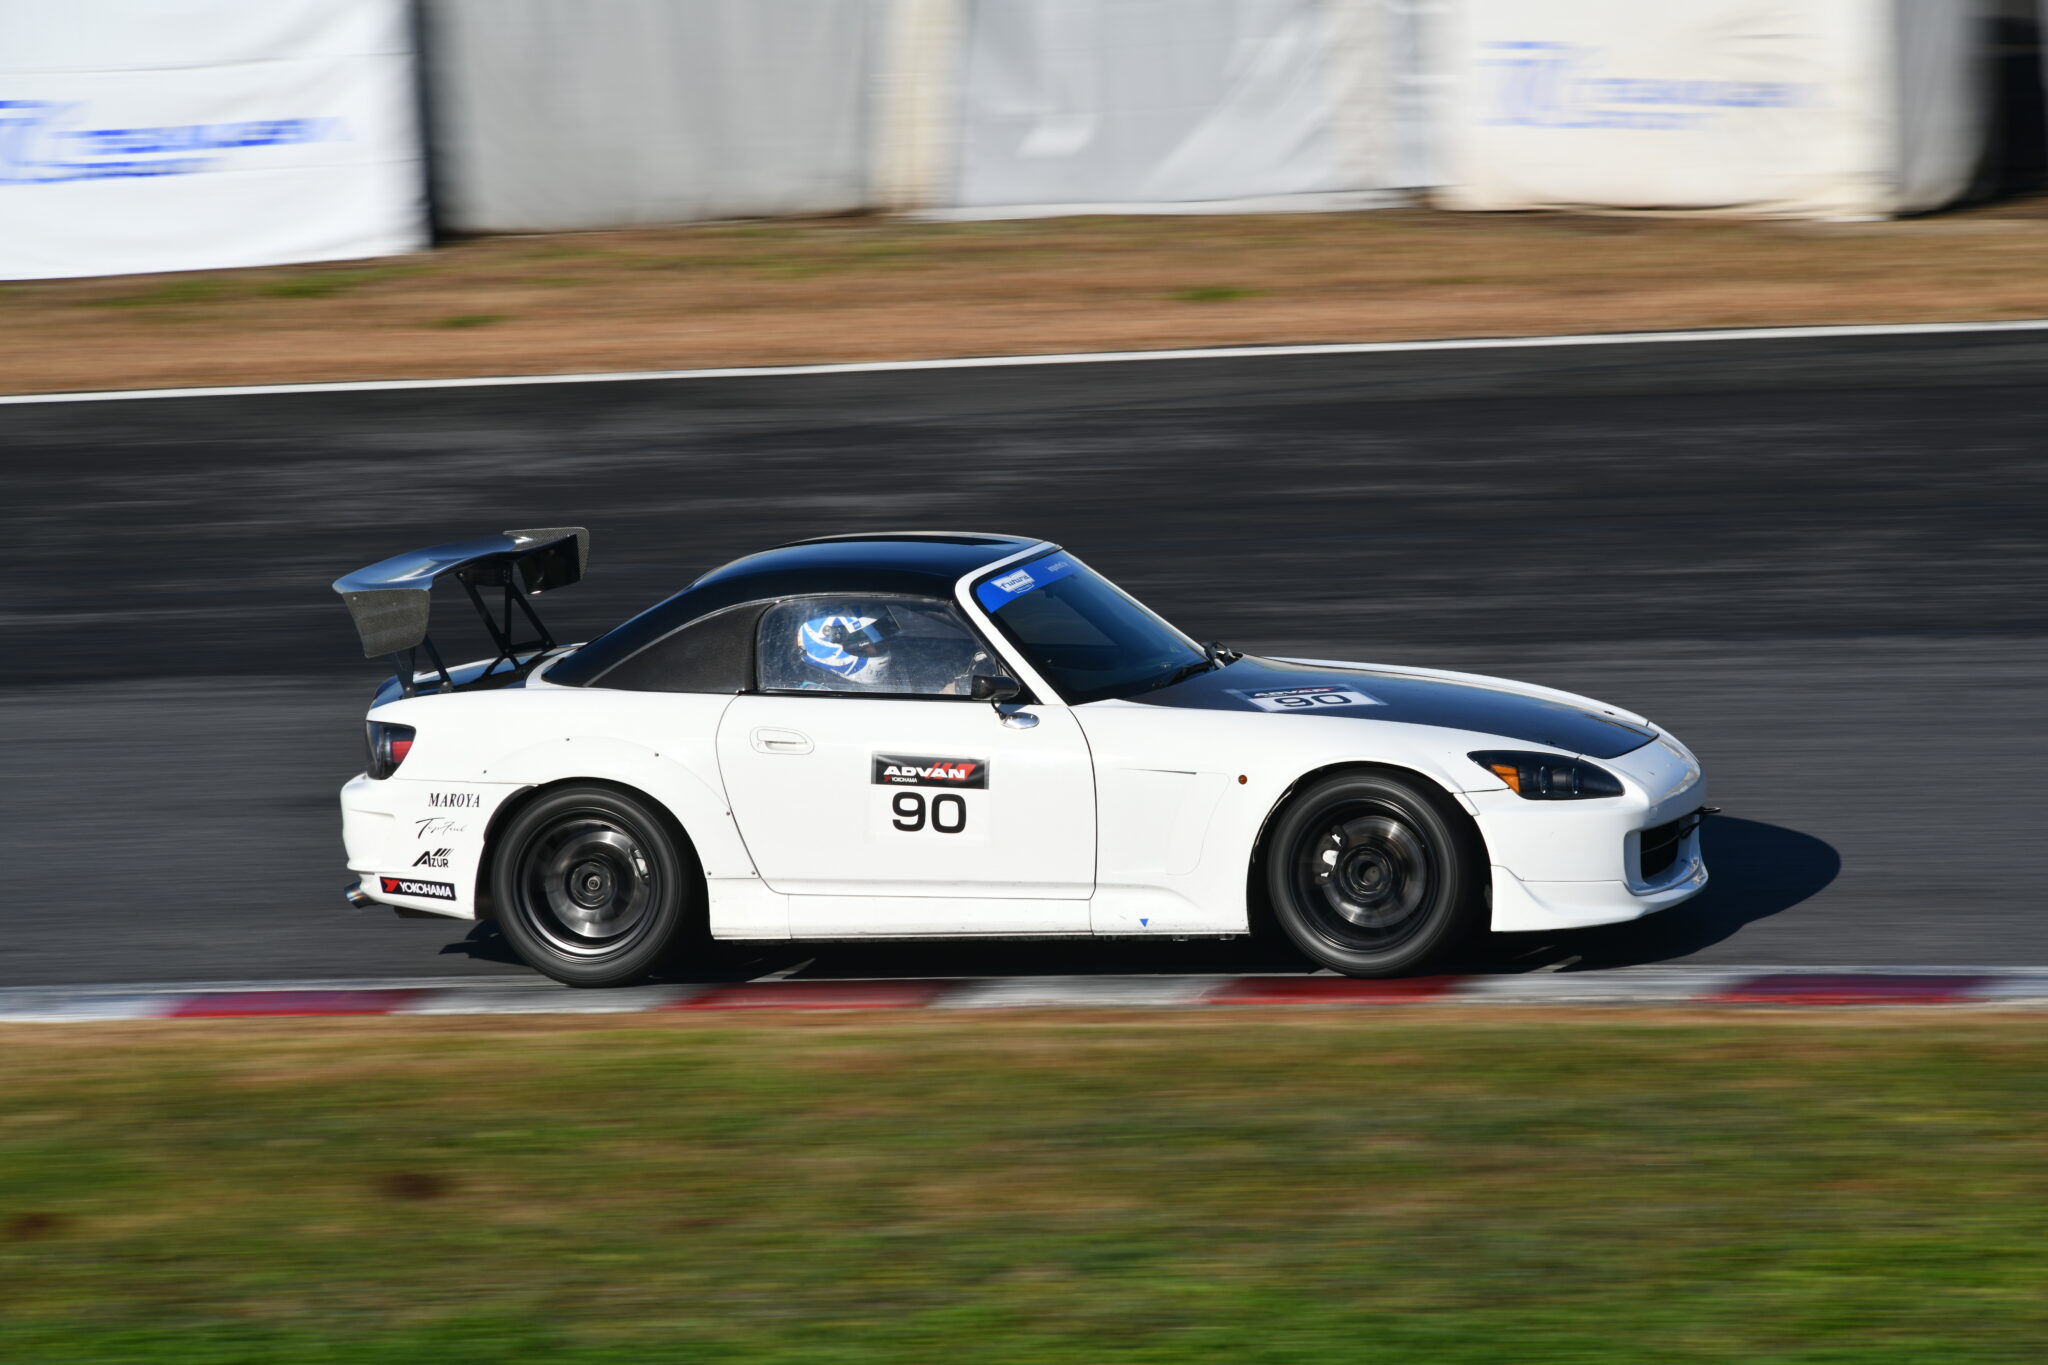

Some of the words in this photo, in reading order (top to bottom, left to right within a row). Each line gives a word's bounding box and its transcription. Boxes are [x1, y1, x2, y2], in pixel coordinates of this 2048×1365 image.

[1274, 694, 1352, 707] 90
[884, 766, 966, 779] ADVAN
[428, 793, 480, 808] MAROYA
[892, 791, 967, 834] 90
[412, 851, 449, 868] AZUR
[399, 881, 452, 897] YOKOHAMA
